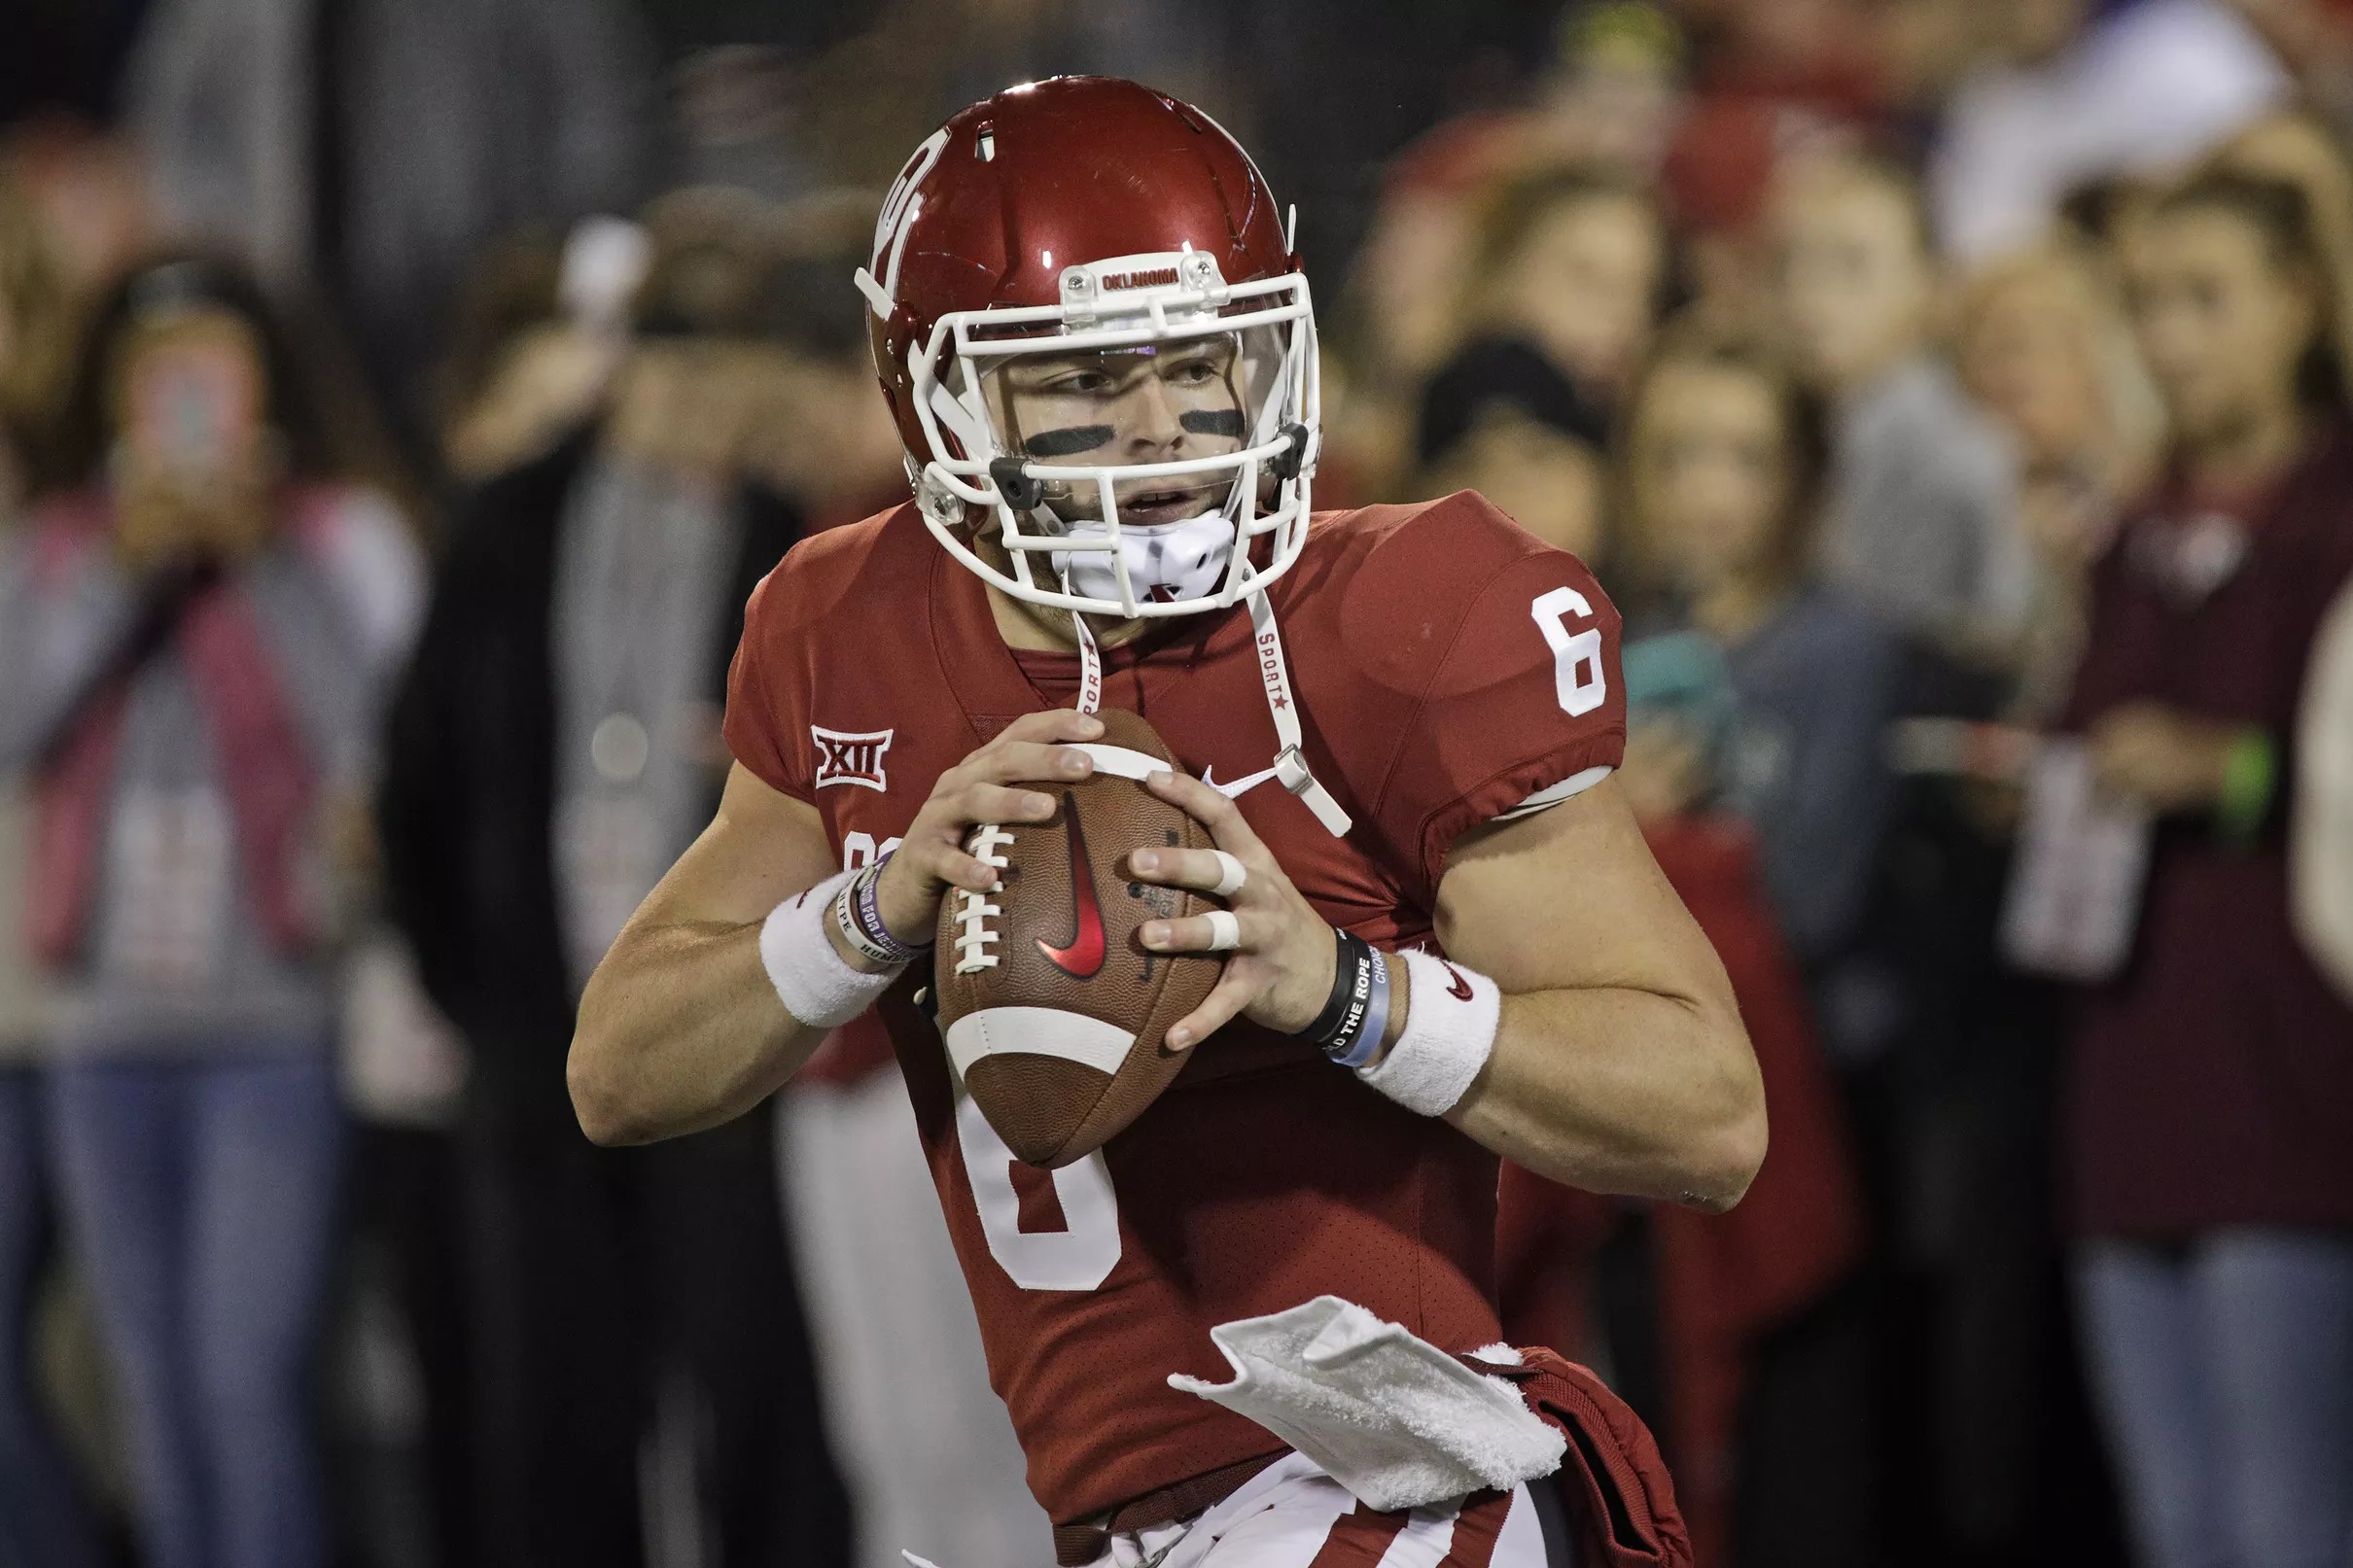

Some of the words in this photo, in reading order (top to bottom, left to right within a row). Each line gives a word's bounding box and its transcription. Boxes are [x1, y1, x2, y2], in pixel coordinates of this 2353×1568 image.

[1102, 267, 1180, 291] OKLAHOMA
[1258, 632, 1282, 694] SPORT
[1530, 585, 1607, 717] 6
[1082, 658, 1100, 716] PORT
[814, 731, 890, 787] XII
[861, 904, 880, 932] FOR
[1340, 1001, 1364, 1034] THE
[1355, 957, 1371, 1000] ROPE
